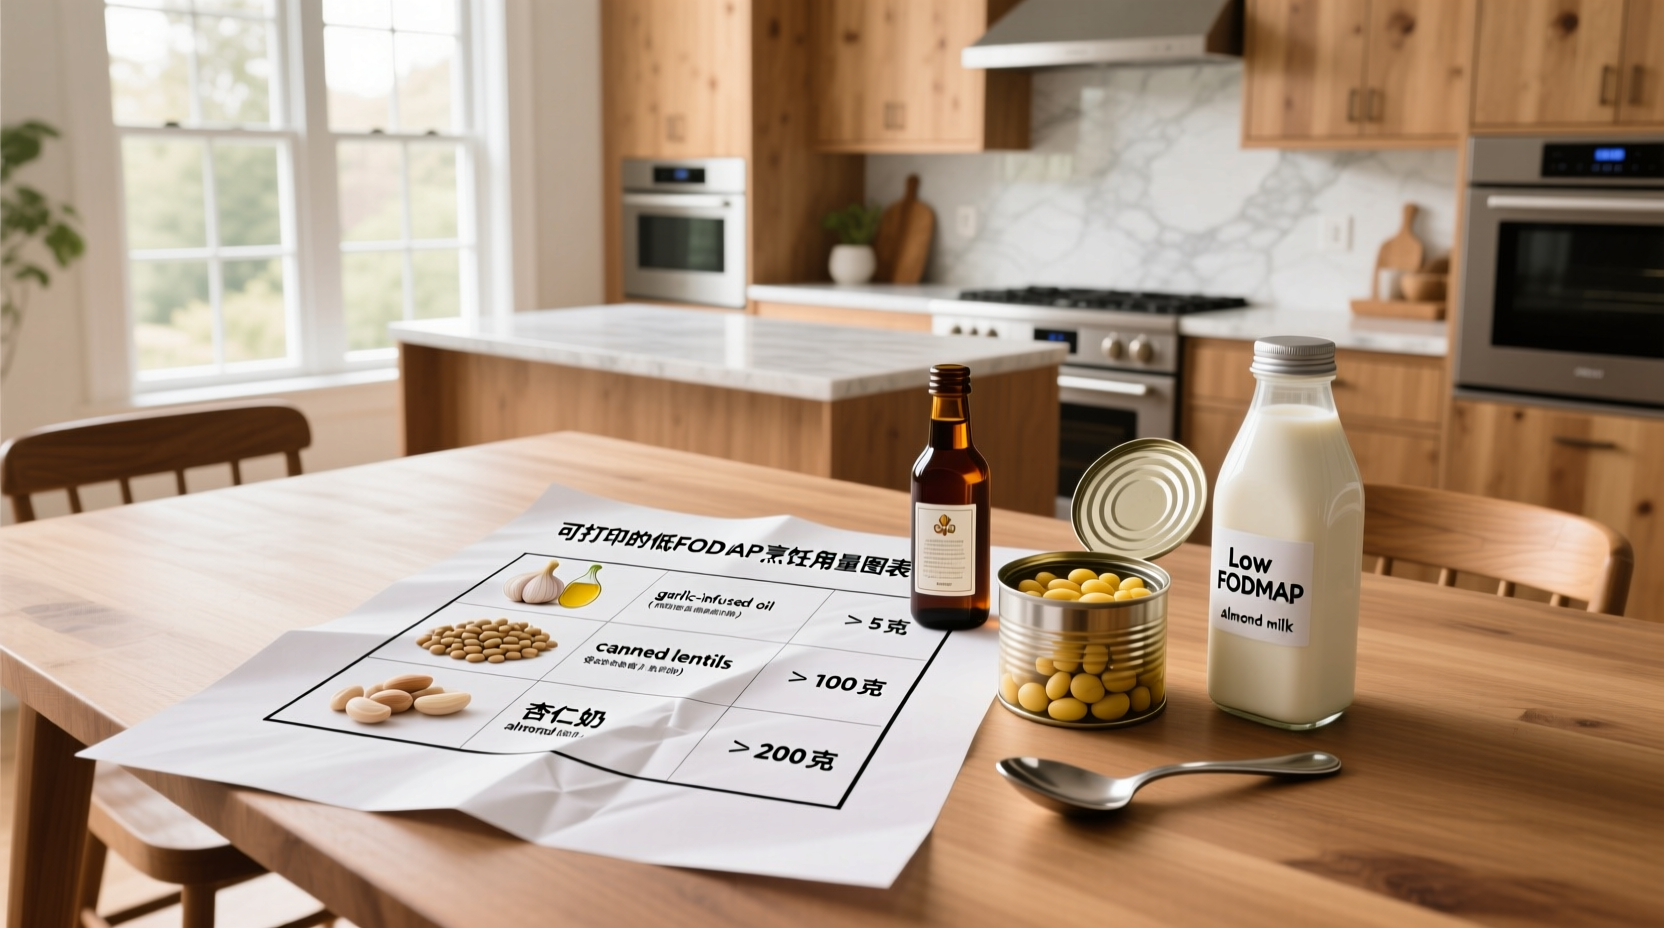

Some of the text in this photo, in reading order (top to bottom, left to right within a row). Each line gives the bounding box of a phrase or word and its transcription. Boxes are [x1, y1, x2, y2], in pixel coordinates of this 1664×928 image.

[1228, 546, 1273, 574] Low
[654, 589, 754, 608] garlic-infused
[755, 600, 776, 611] oil
[1217, 569, 1305, 605] FODMAP
[1220, 606, 1295, 633] almond milk
[595, 643, 670, 660] canned
[670, 649, 733, 670] lentils
[522, 701, 607, 729] 杏仁奶
